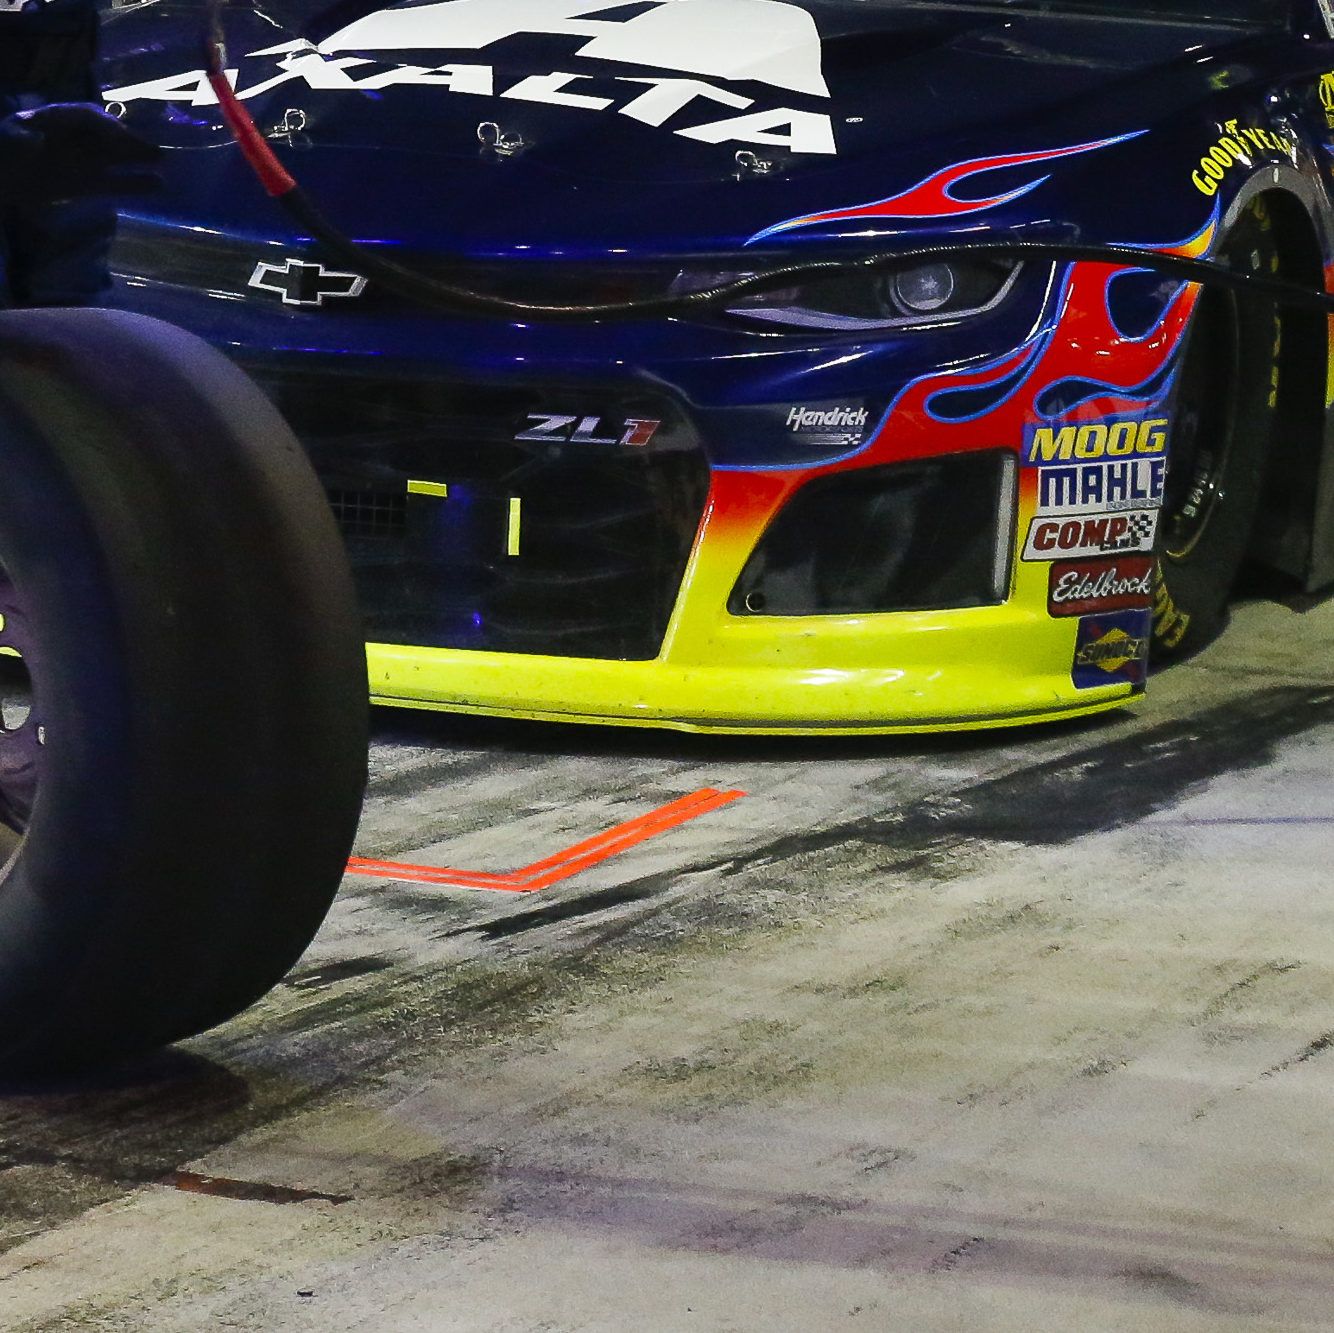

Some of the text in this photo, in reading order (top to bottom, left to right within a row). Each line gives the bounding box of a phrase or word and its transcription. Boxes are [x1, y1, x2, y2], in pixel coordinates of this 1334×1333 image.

[101, 40, 837, 156] AXALTA
[1192, 118, 1297, 196] GOODYEAR
[514, 412, 660, 446] ZL1
[786, 407, 869, 431] Hendrick
[1029, 419, 1169, 462] MOOG
[1040, 460, 1165, 507] MAHLE
[1034, 517, 1128, 551] COMP
[1052, 567, 1152, 603] Edelbrock
